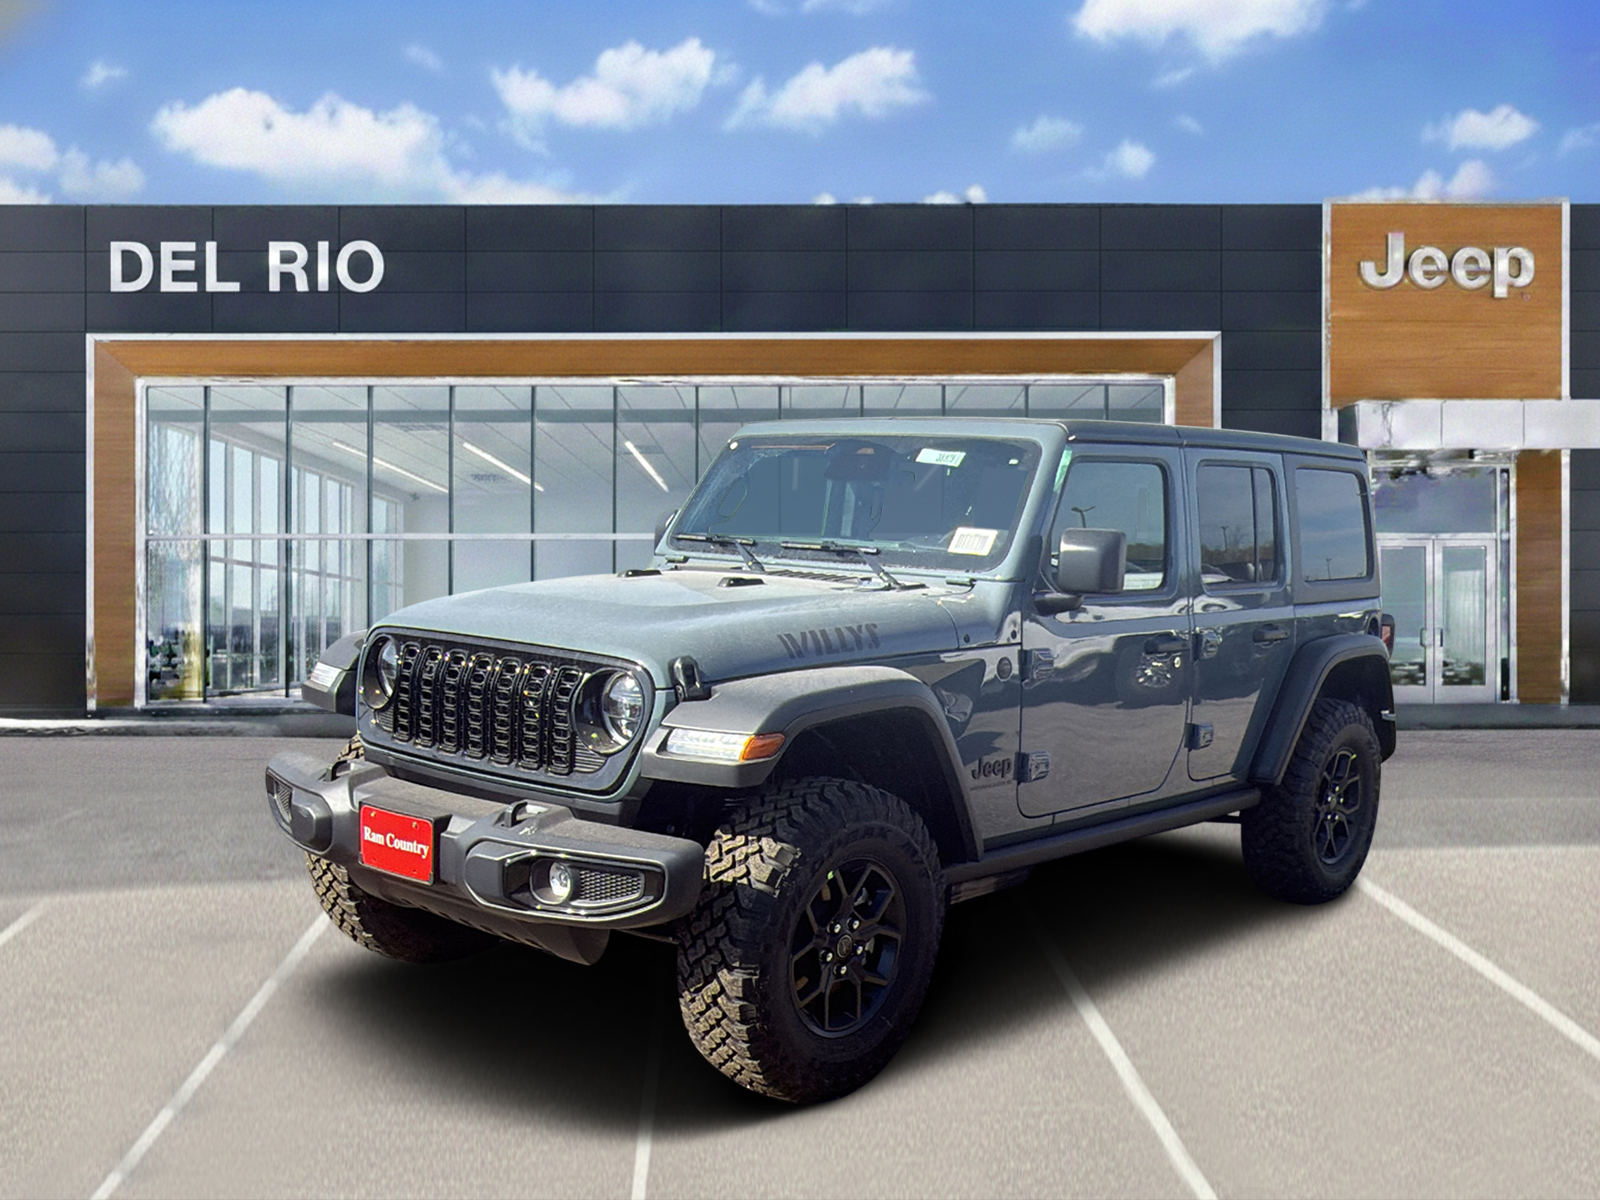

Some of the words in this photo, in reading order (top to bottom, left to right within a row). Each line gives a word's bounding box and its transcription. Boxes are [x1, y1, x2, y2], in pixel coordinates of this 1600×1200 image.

[110, 241, 240, 292] DEL
[268, 240, 385, 293] RIO
[1359, 231, 1535, 298] Jeep
[777, 623, 881, 659] WILLYS
[971, 757, 1012, 779] Jeep
[364, 826, 385, 846] Ram
[386, 833, 429, 859] Country
